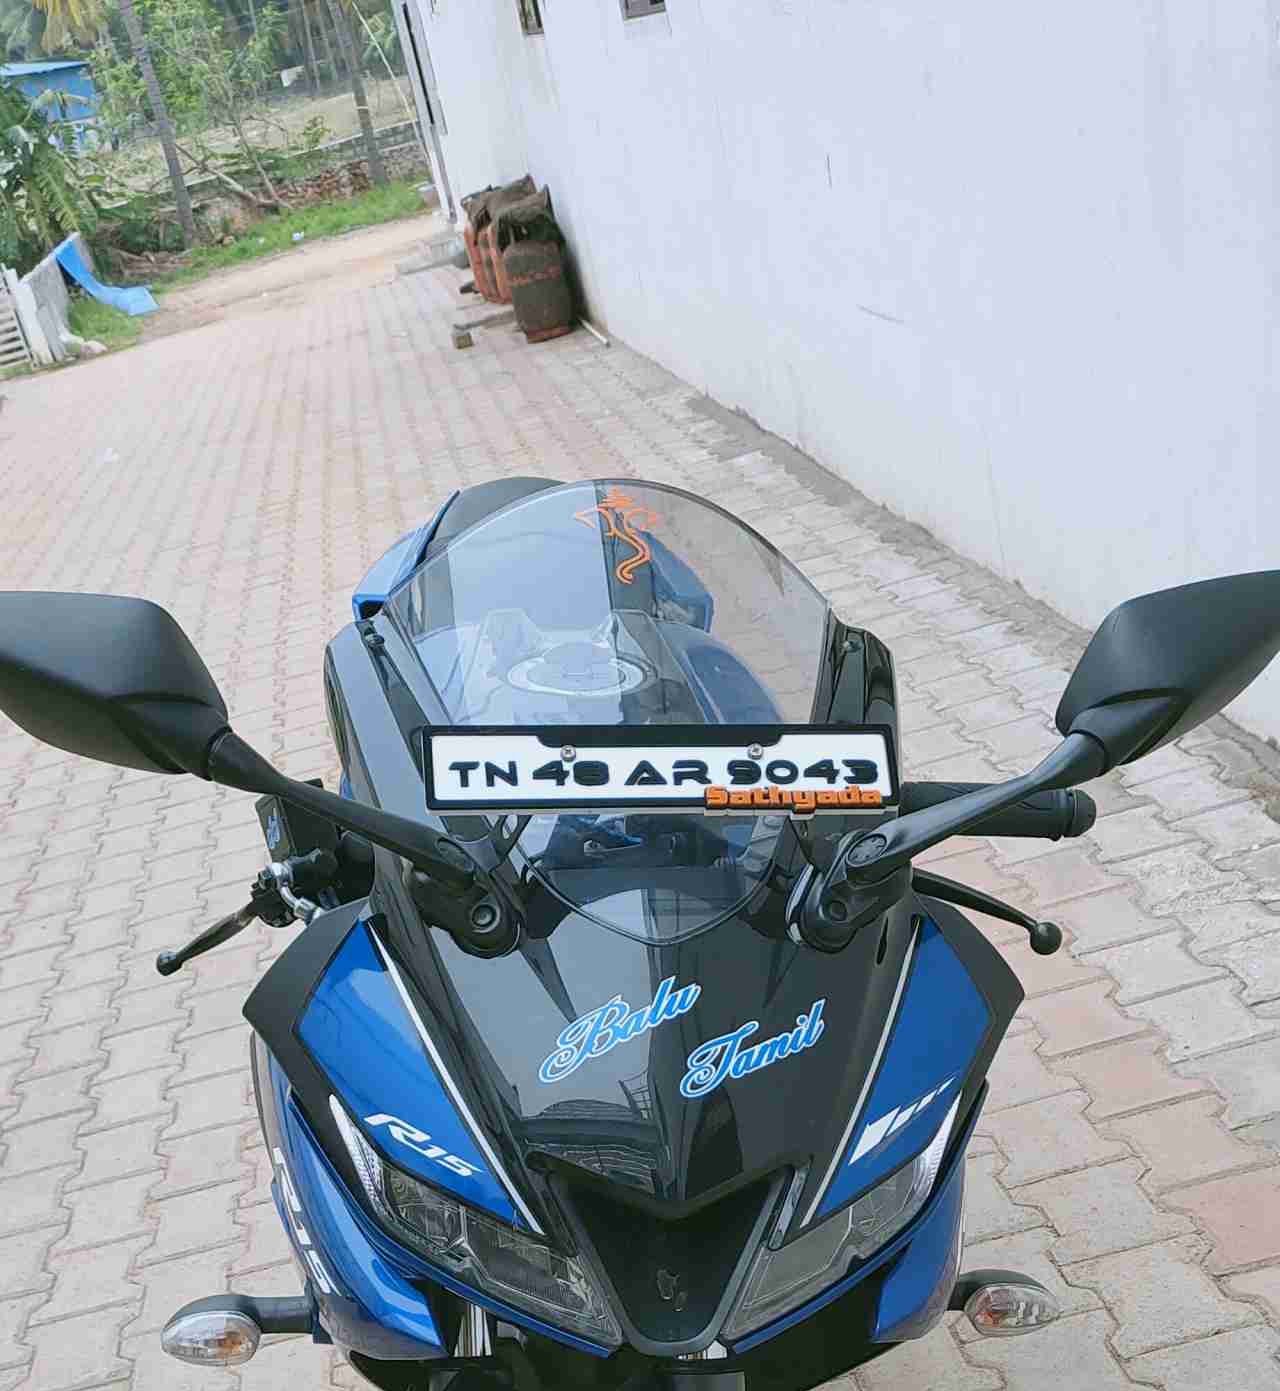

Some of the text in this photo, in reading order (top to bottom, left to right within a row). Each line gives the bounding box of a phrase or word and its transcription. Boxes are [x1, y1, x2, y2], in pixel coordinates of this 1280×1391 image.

[448, 758, 879, 788] TN 48 AR 9043
[538, 976, 701, 1083] Balu
[679, 999, 826, 1098] Tamil
[364, 1113, 483, 1177] R15
